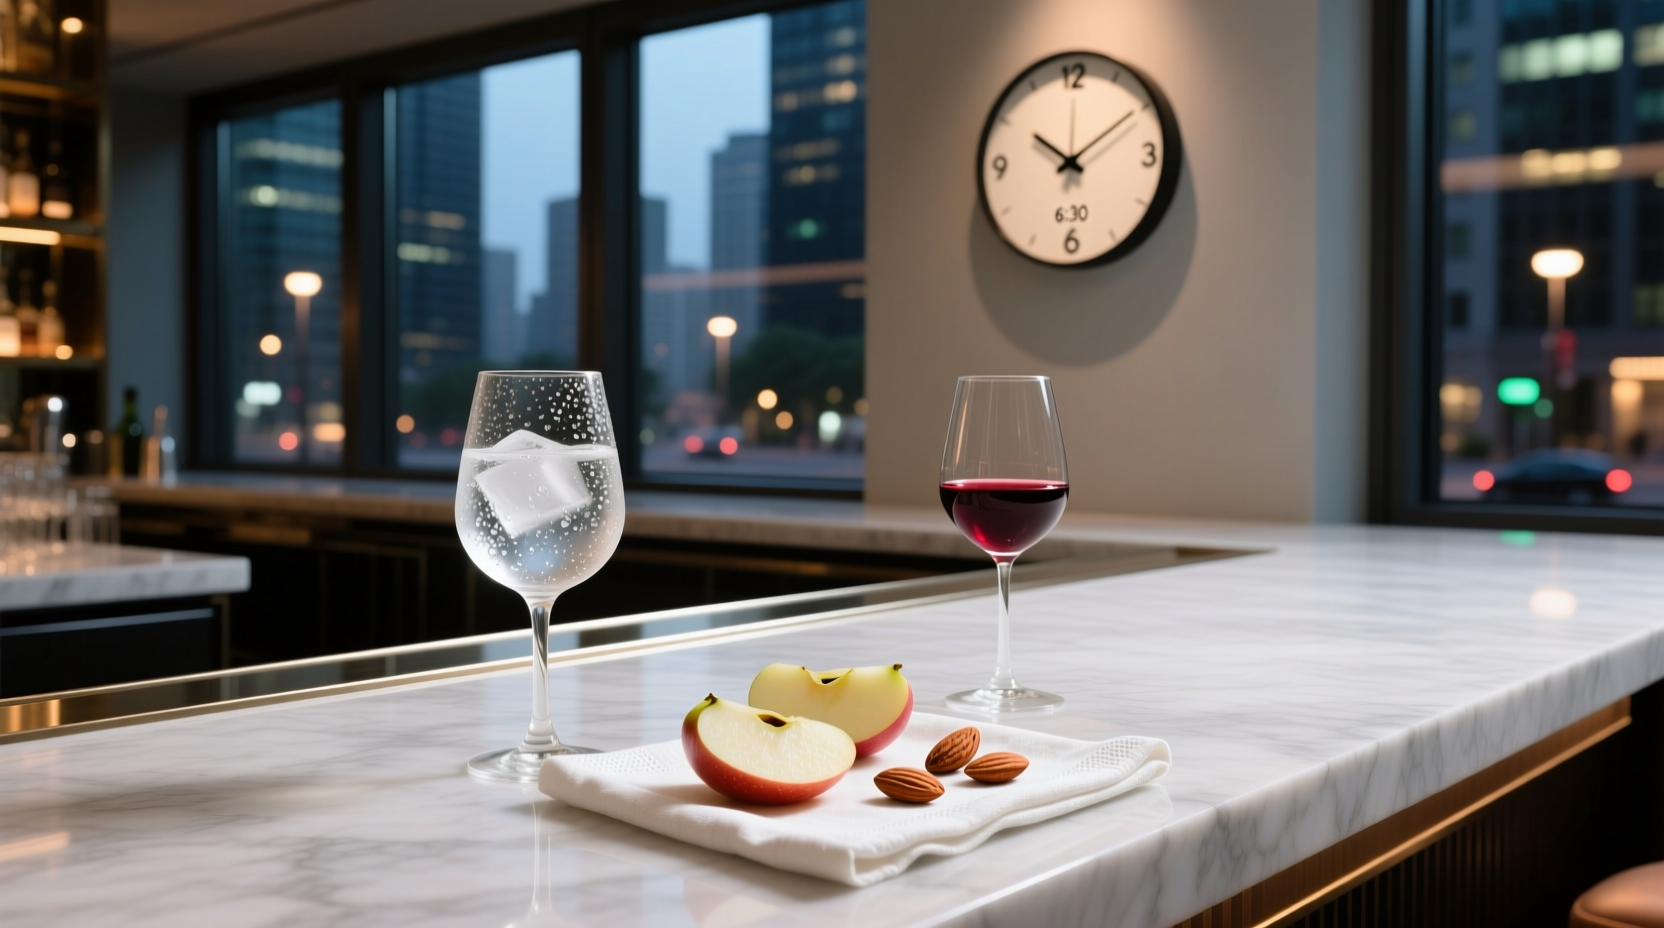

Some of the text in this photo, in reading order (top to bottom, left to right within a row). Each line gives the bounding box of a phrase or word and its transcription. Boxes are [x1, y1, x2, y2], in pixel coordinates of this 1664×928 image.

[1062, 63, 1086, 89] 12
[992, 155, 1008, 180] 9
[1141, 142, 1157, 168] 3
[1055, 204, 1088, 223] 6:30
[1064, 228, 1080, 254] 6
